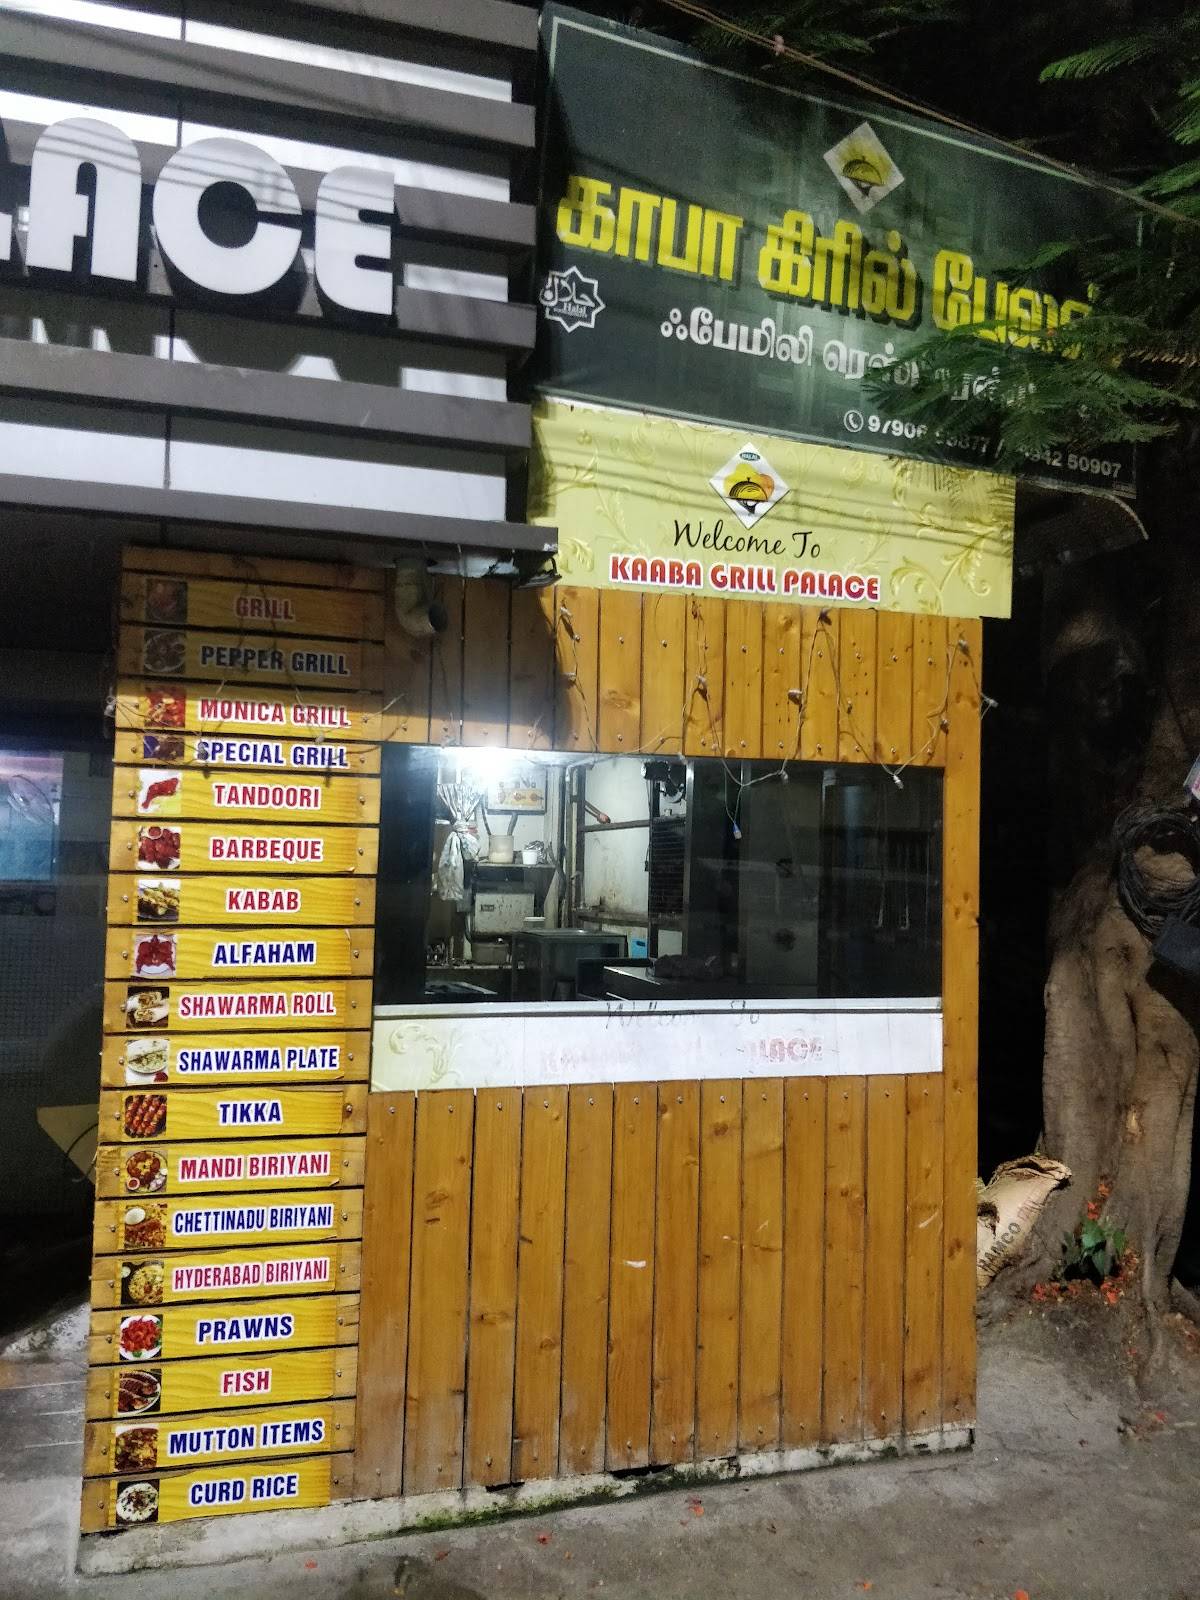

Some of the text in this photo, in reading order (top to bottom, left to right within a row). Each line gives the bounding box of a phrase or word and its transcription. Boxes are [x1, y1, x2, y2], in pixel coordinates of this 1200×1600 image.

[0, 117, 396, 315] ACE
[556, 175, 744, 282] காபா
[758, 209, 918, 321] கிரில்
[660, 307, 813, 367] ஃபேமிலி
[1068, 453, 1122, 478] 50907
[674, 519, 821, 559] Welcome To
[611, 555, 880, 600] KAABA GRILL PALACE
[236, 598, 294, 620] GRILL
[201, 645, 349, 676] PEPPER GRILL
[200, 698, 350, 727] MONICA GRILL
[197, 740, 349, 768] SPECIAL GRILL
[215, 785, 320, 808] TANDOORI
[211, 839, 322, 861] BARBEQUE
[228, 890, 299, 911] KABAB
[214, 943, 315, 965] ALFAHAM
[180, 993, 334, 1017] SHAWARMA ROLL
[178, 1047, 339, 1072] SHAWARMA PLATE
[220, 1102, 281, 1123] TIKKA
[180, 1153, 329, 1180] MANDI BIRIYANI
[174, 1206, 332, 1233] CHETTINADU BIRIYANI
[174, 1259, 328, 1290] HYDERABAD BIRIYANI
[198, 1315, 293, 1342] PRAWNS
[223, 1370, 270, 1393] FISH
[170, 1420, 324, 1455] MUTTON ITEMS
[191, 1475, 297, 1505] CURD RICE
